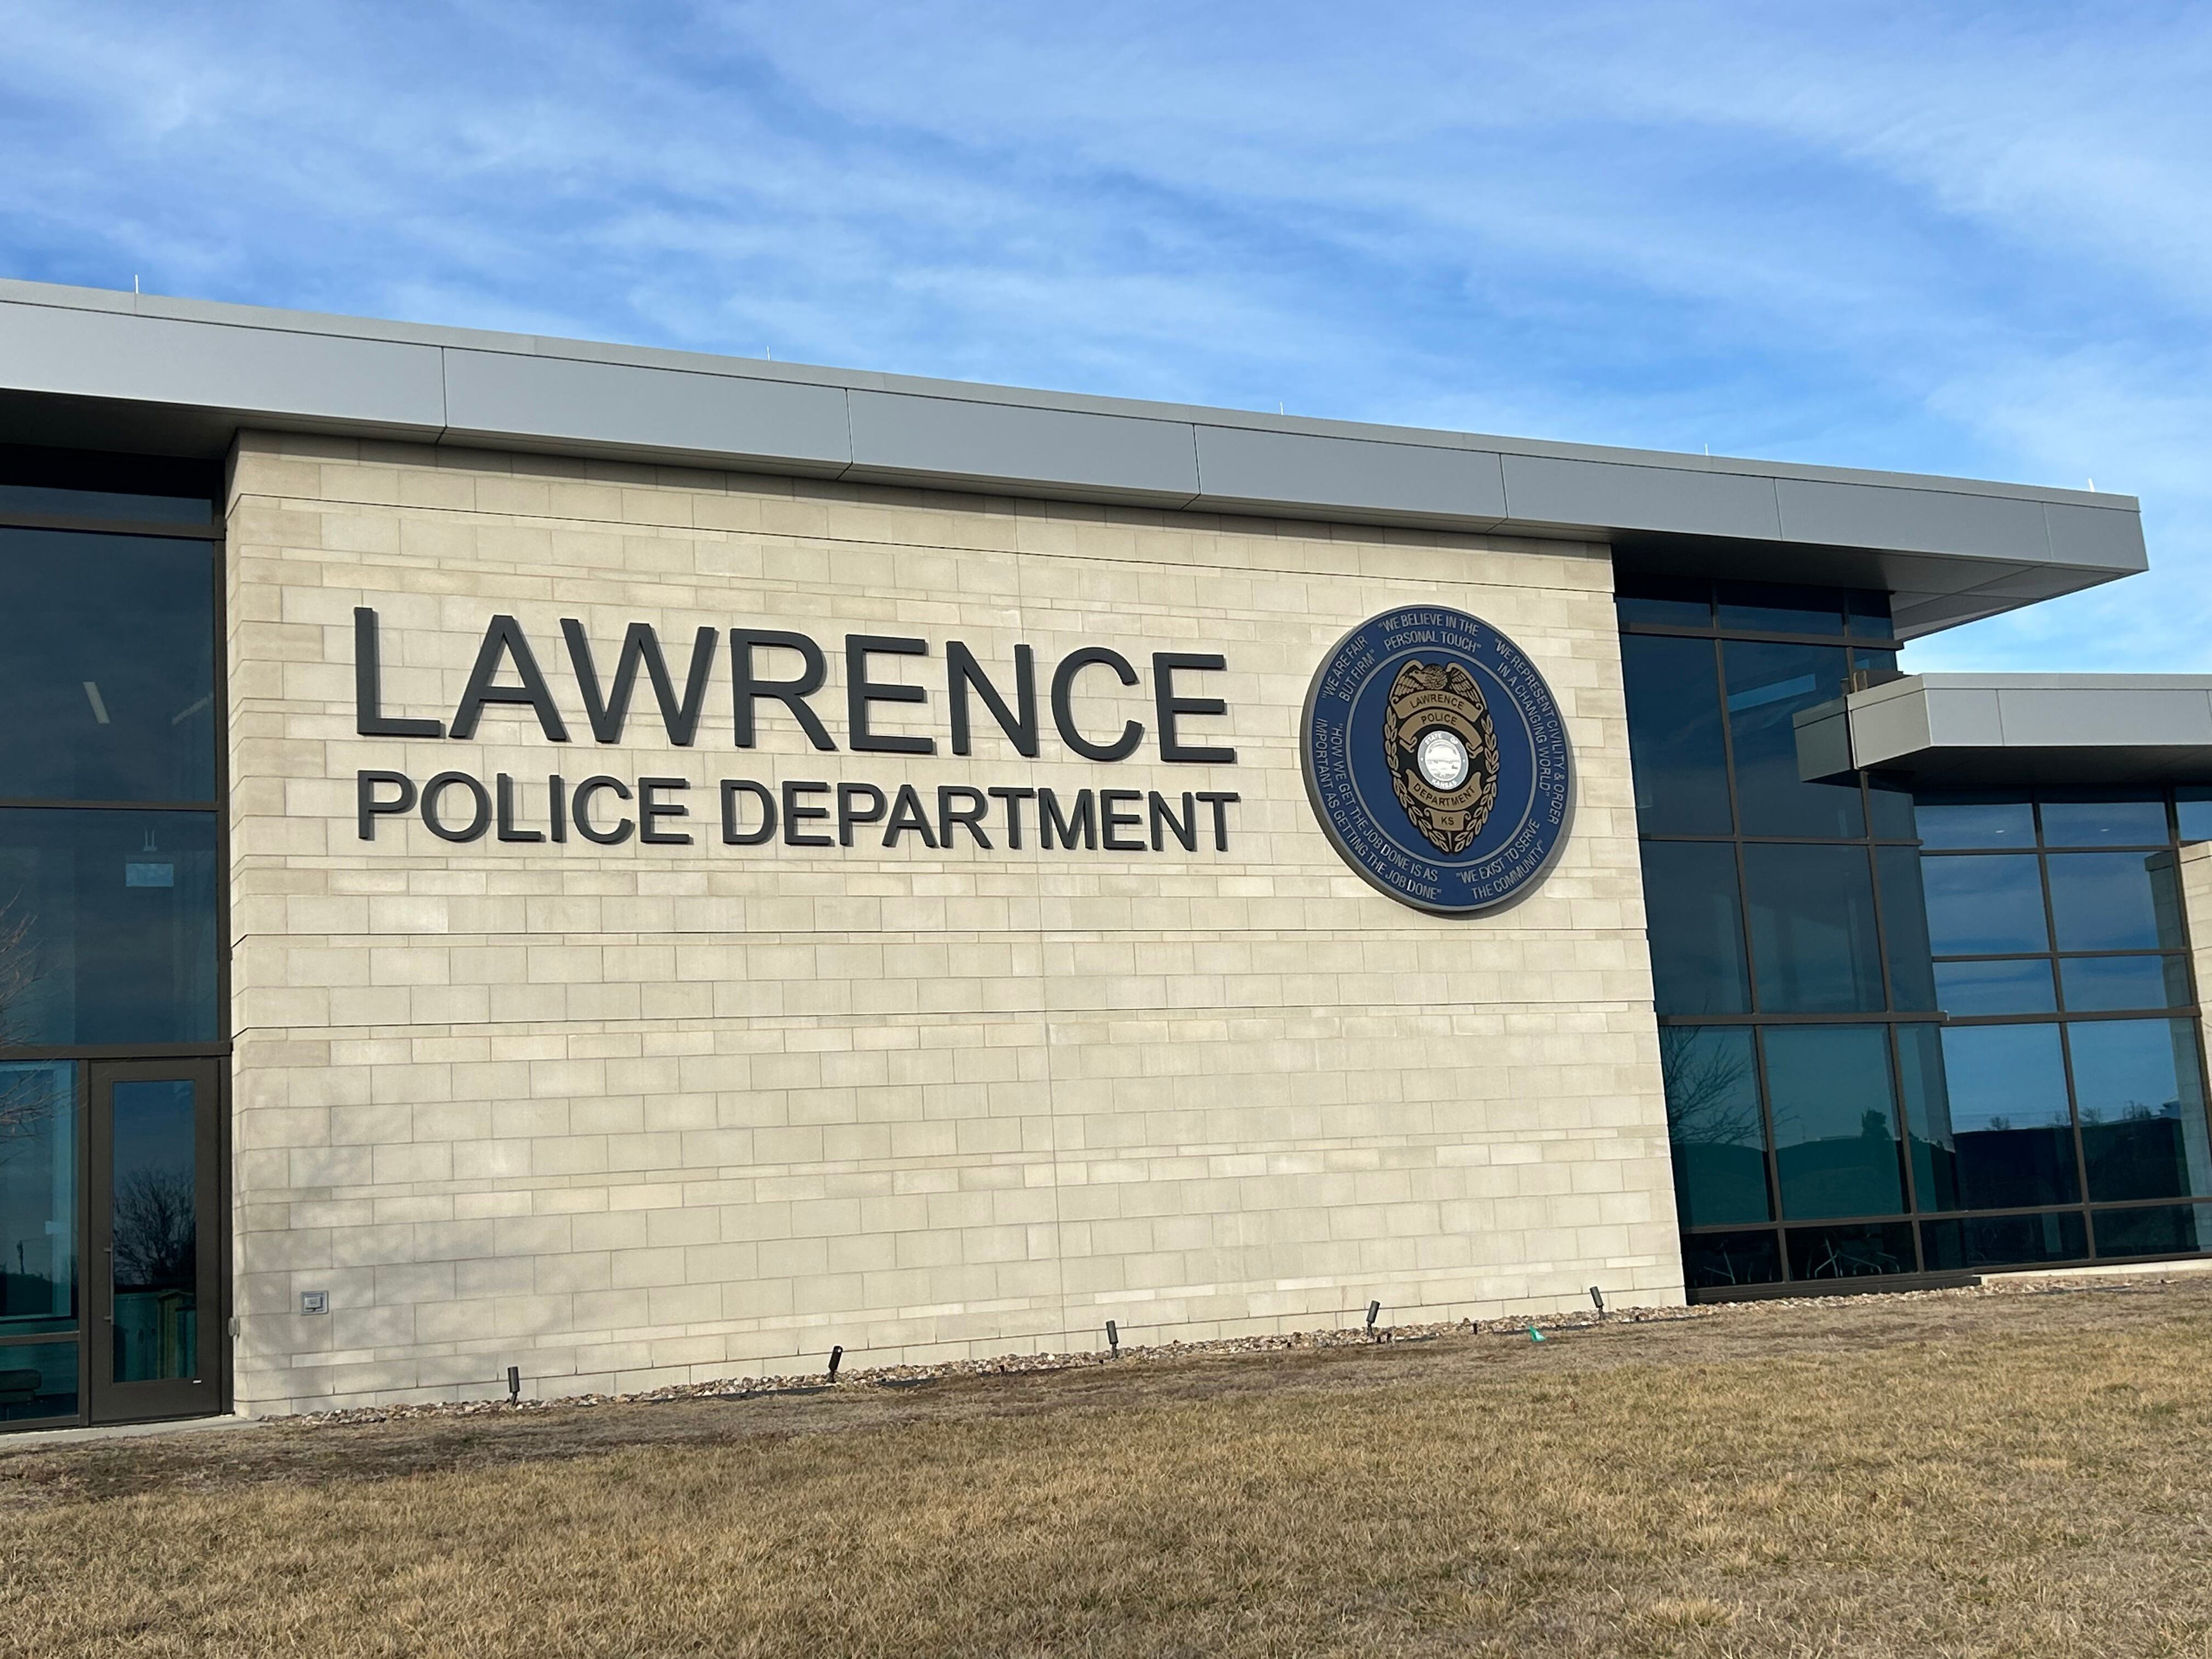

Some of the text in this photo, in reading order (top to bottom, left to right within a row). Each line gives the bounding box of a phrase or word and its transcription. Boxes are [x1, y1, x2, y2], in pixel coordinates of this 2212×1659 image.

[1401, 613, 1443, 627] BELIEVE
[1445, 615, 1456, 629] IN
[1459, 619, 1480, 636] THE
[1384, 630, 1439, 651] PERSONAL
[1334, 655, 1351, 679] ARE
[1346, 635, 1368, 659] FAIR
[354, 607, 1235, 763] LAWRENCE
[1339, 677, 1357, 702] BUT
[1510, 655, 1554, 717] REPRESENT
[1409, 693, 1465, 710] LAWRENCE
[1497, 662, 1509, 678] IN
[1507, 676, 1517, 687] A
[1515, 684, 1548, 744] CHANGING
[1421, 712, 1458, 726] POLICE
[1425, 733, 1443, 745] STATE
[1546, 720, 1565, 770] CIVILITY
[1333, 759, 1347, 780] WE
[1339, 781, 1356, 807] GET
[1414, 782, 1476, 807] DEPARTMENT
[1431, 778, 1458, 789] KANSAS
[358, 770, 1240, 851] POLICE DEPARTMENT
[1315, 718, 1334, 790] IMPORTANT
[1325, 792, 1340, 809] AS
[1333, 809, 1368, 857] GETTING
[1367, 852, 1388, 875] THE
[1385, 870, 1406, 888] JOB
[1548, 784, 1565, 825] ORDER
[1350, 806, 1370, 831] THE
[1440, 816, 1454, 826] KS
[1363, 830, 1384, 850] JOB
[1479, 857, 1506, 880] EXIST
[1505, 847, 1519, 864] TO
[1516, 818, 1540, 853] SERVE
[1380, 843, 1409, 871] DONE
[1411, 863, 1423, 877] IS
[1423, 869, 1438, 882] AS
[1471, 884, 1493, 900] THE
